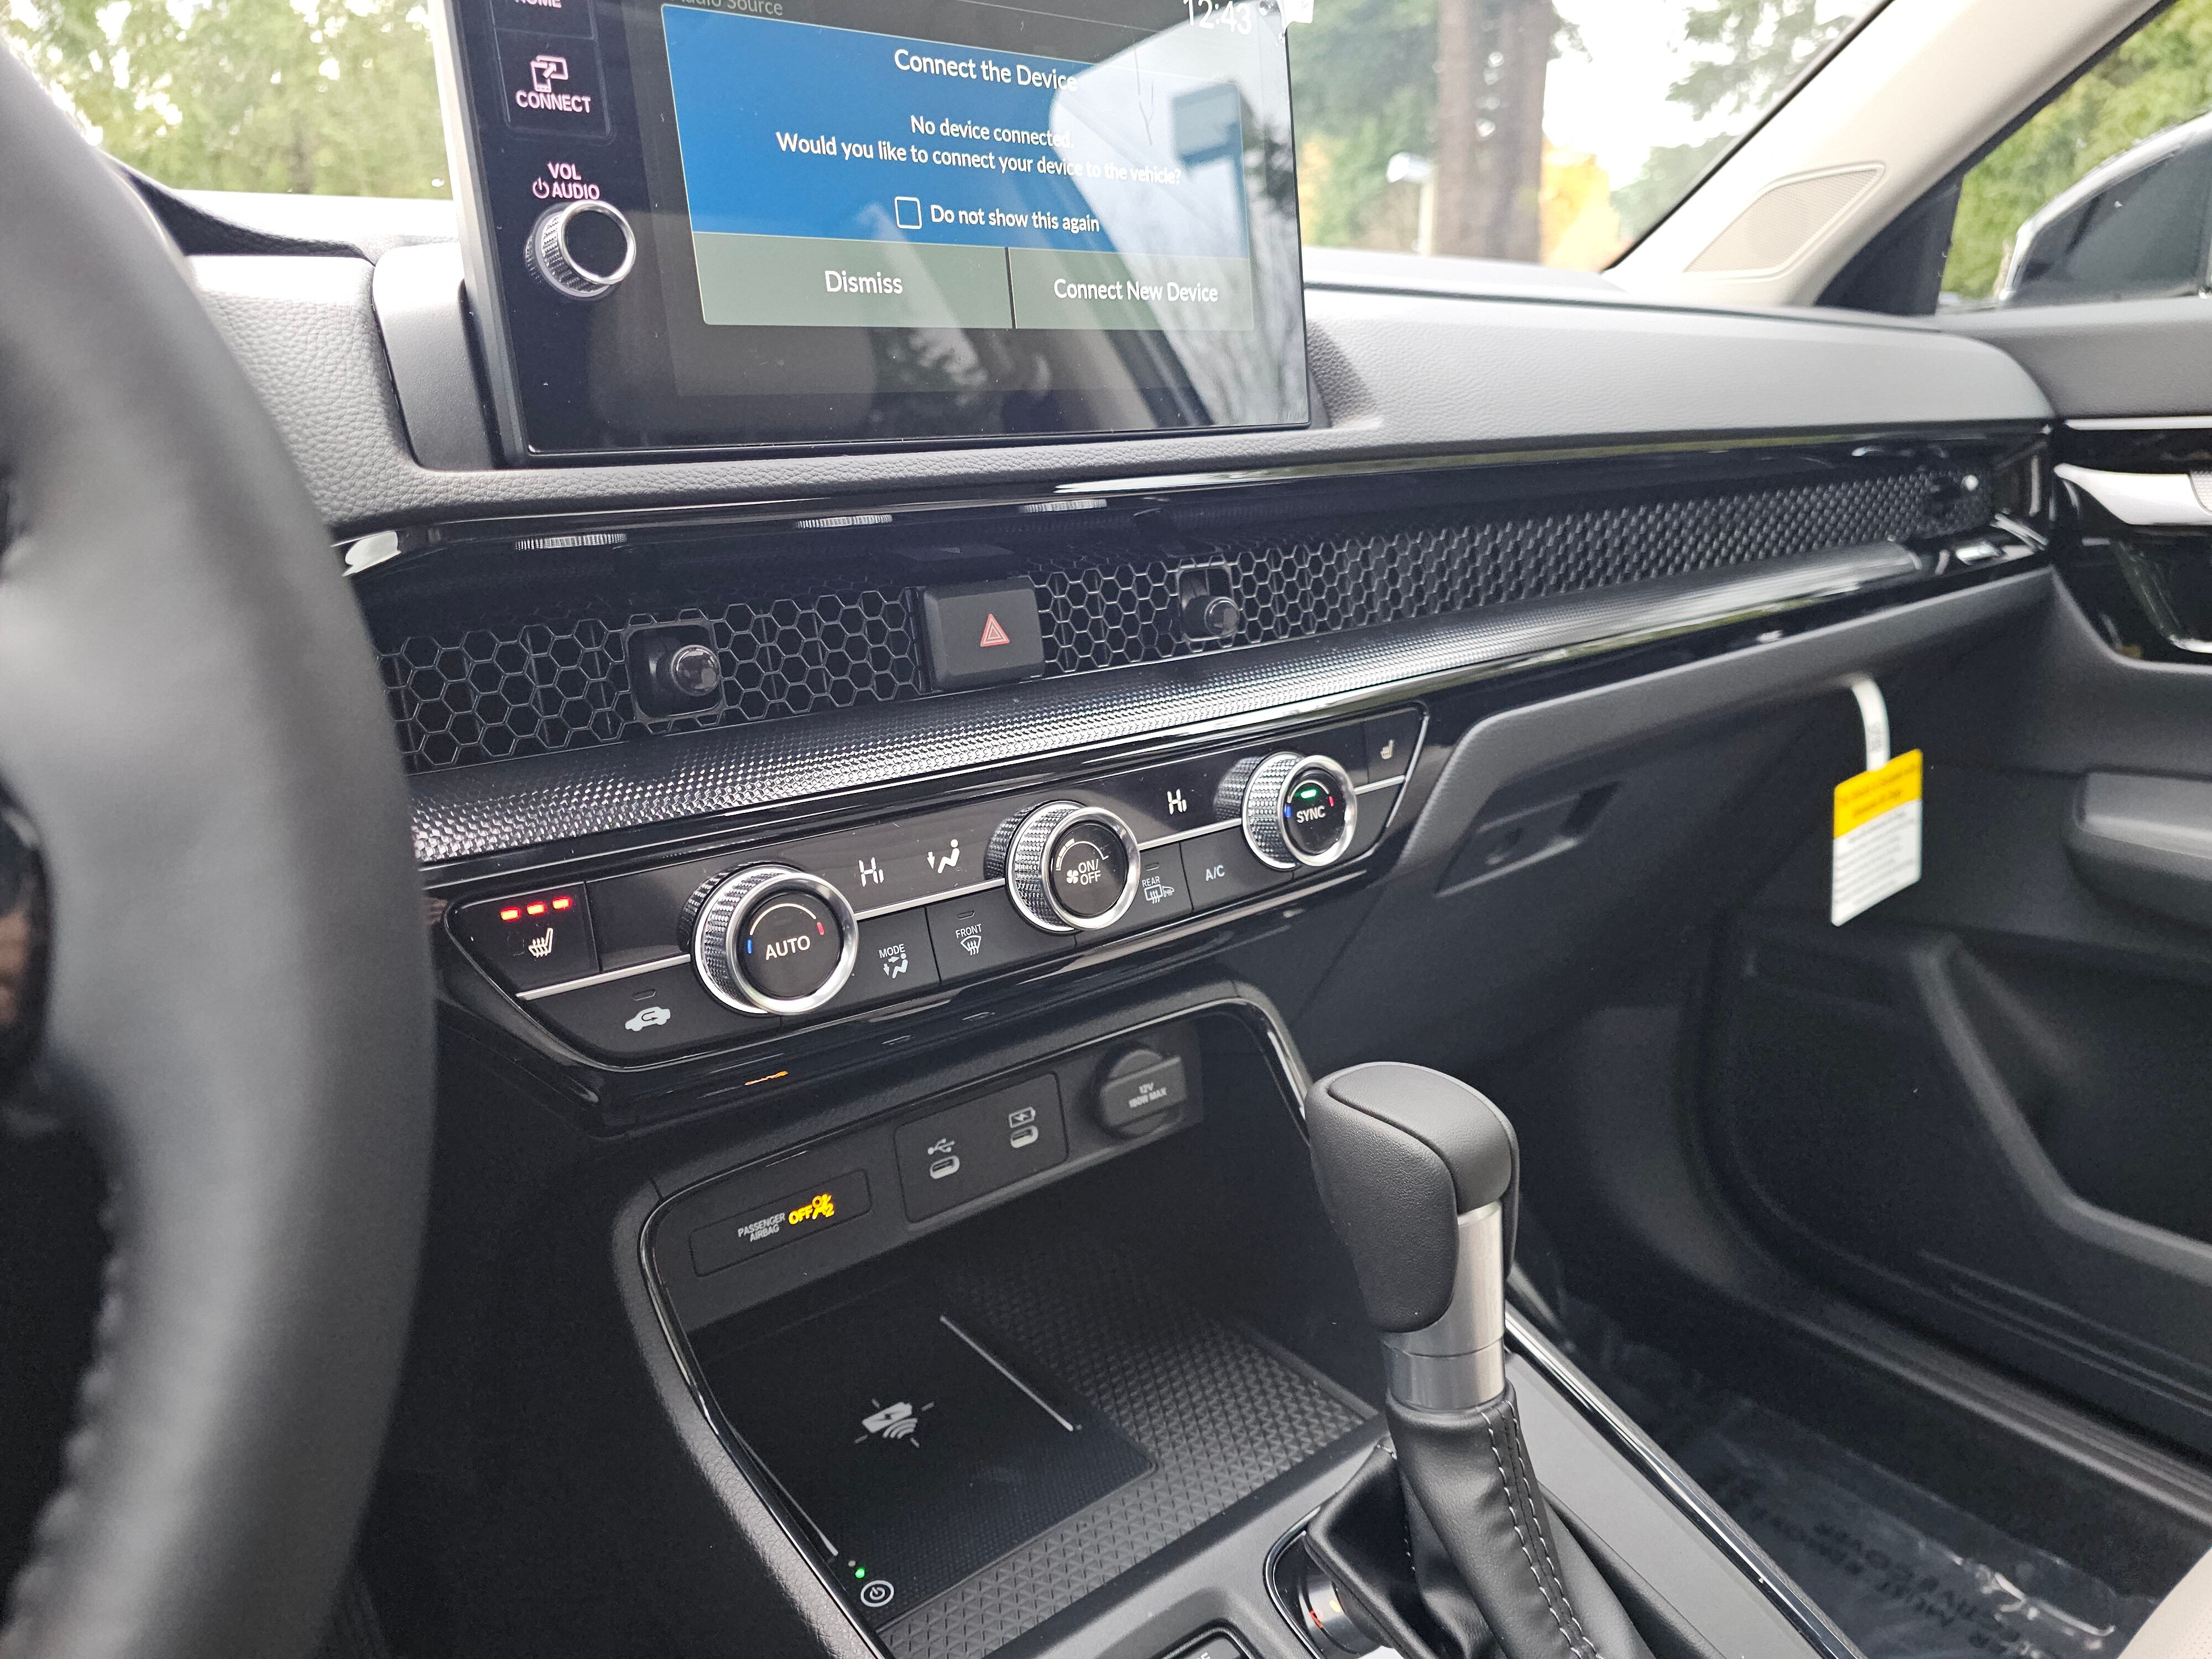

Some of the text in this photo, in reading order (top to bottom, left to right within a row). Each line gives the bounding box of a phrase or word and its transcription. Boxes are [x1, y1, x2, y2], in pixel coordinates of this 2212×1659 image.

[1183, 0, 1252, 35] 12:43
[894, 49, 1078, 92] Connect the Device
[515, 90, 591, 113] CONNECT
[910, 115, 1074, 149] No device connected.
[776, 132, 1182, 185] Would you like to connect your device to the vehicle?
[547, 162, 582, 180] VOL
[551, 181, 600, 200] AUDIO
[930, 205, 1100, 234] Do not show this again
[825, 270, 904, 294] Dismiss
[1054, 278, 1218, 302] Connect New Device
[1296, 805, 1326, 823] SYNC
[1079, 870, 1101, 885] OFF
[1141, 876, 1161, 888] REAR
[1205, 864, 1225, 881] A/C
[955, 924, 982, 939] FRONT
[766, 935, 811, 961] AUTO
[879, 943, 905, 958] MODE
[1139, 1082, 1154, 1094] 12V
[1149, 1087, 1167, 1100] MAX
[789, 1204, 813, 1225] OFF
[737, 1212, 785, 1238] PASSENGER
[750, 1224, 780, 1242] AIRBAG
